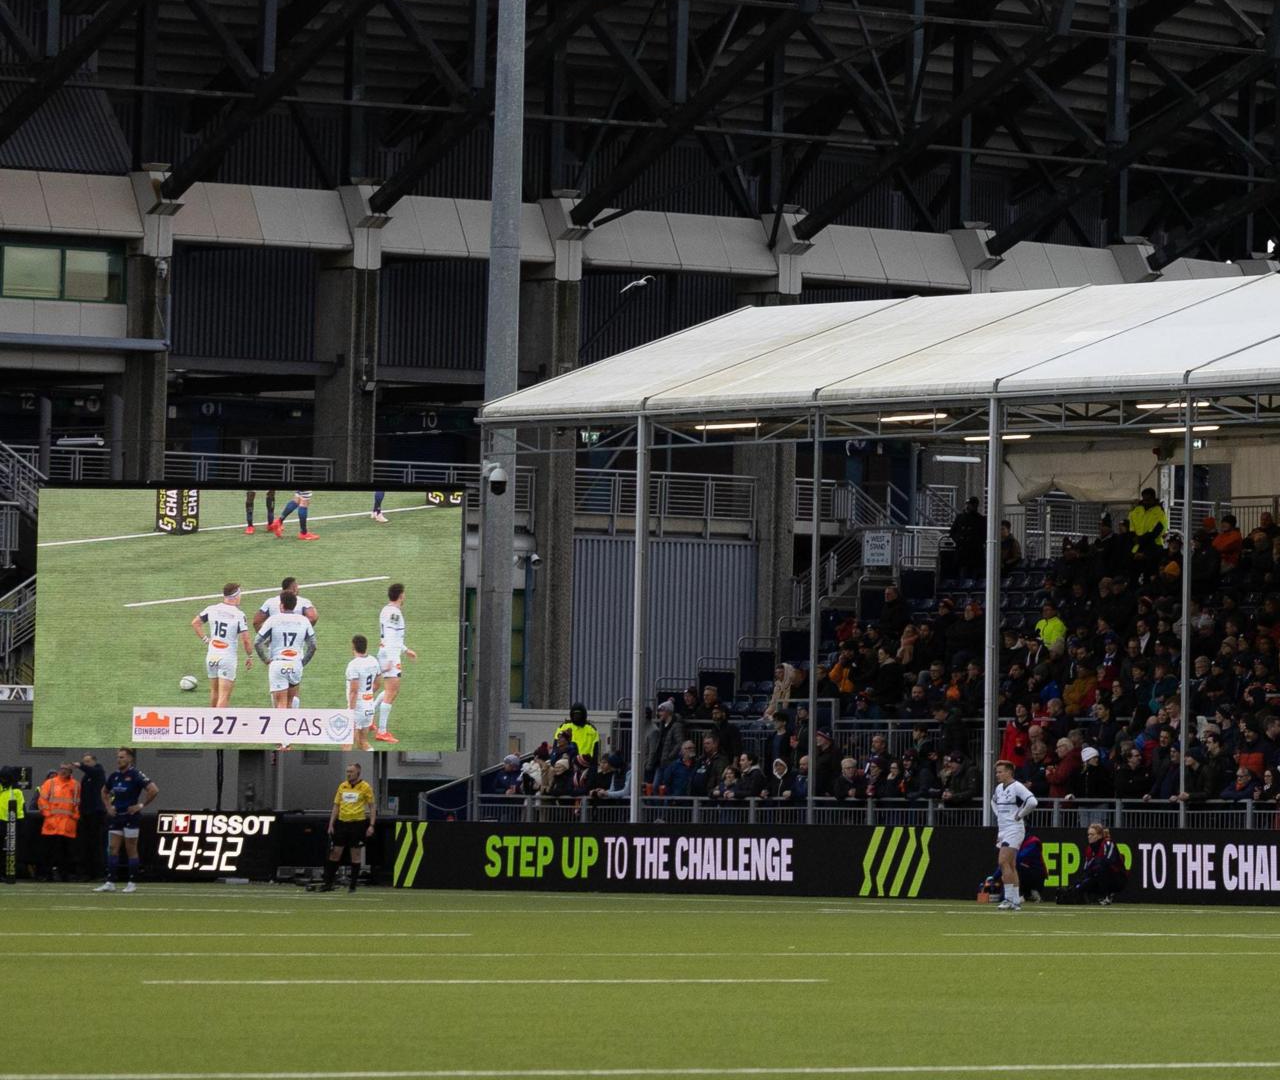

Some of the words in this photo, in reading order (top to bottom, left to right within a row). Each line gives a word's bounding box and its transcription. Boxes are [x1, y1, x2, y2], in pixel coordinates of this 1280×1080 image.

[420, 411, 437, 428] 10
[282, 632, 297, 647] 17
[134, 727, 170, 735] EDINBURGH
[174, 717, 205, 735] EDI
[212, 716, 237, 734] 27
[259, 717, 271, 735] 7
[284, 718, 322, 736] CAS
[191, 815, 276, 835] TISSOT
[158, 836, 244, 871] 43:32
[485, 836, 554, 878] STEP
[561, 837, 598, 879] UP
[604, 837, 628, 880] TO
[633, 837, 670, 880] THE
[675, 837, 793, 882] CHALLENGE
[1138, 843, 1166, 890] TO
[1173, 843, 1215, 890] THE
